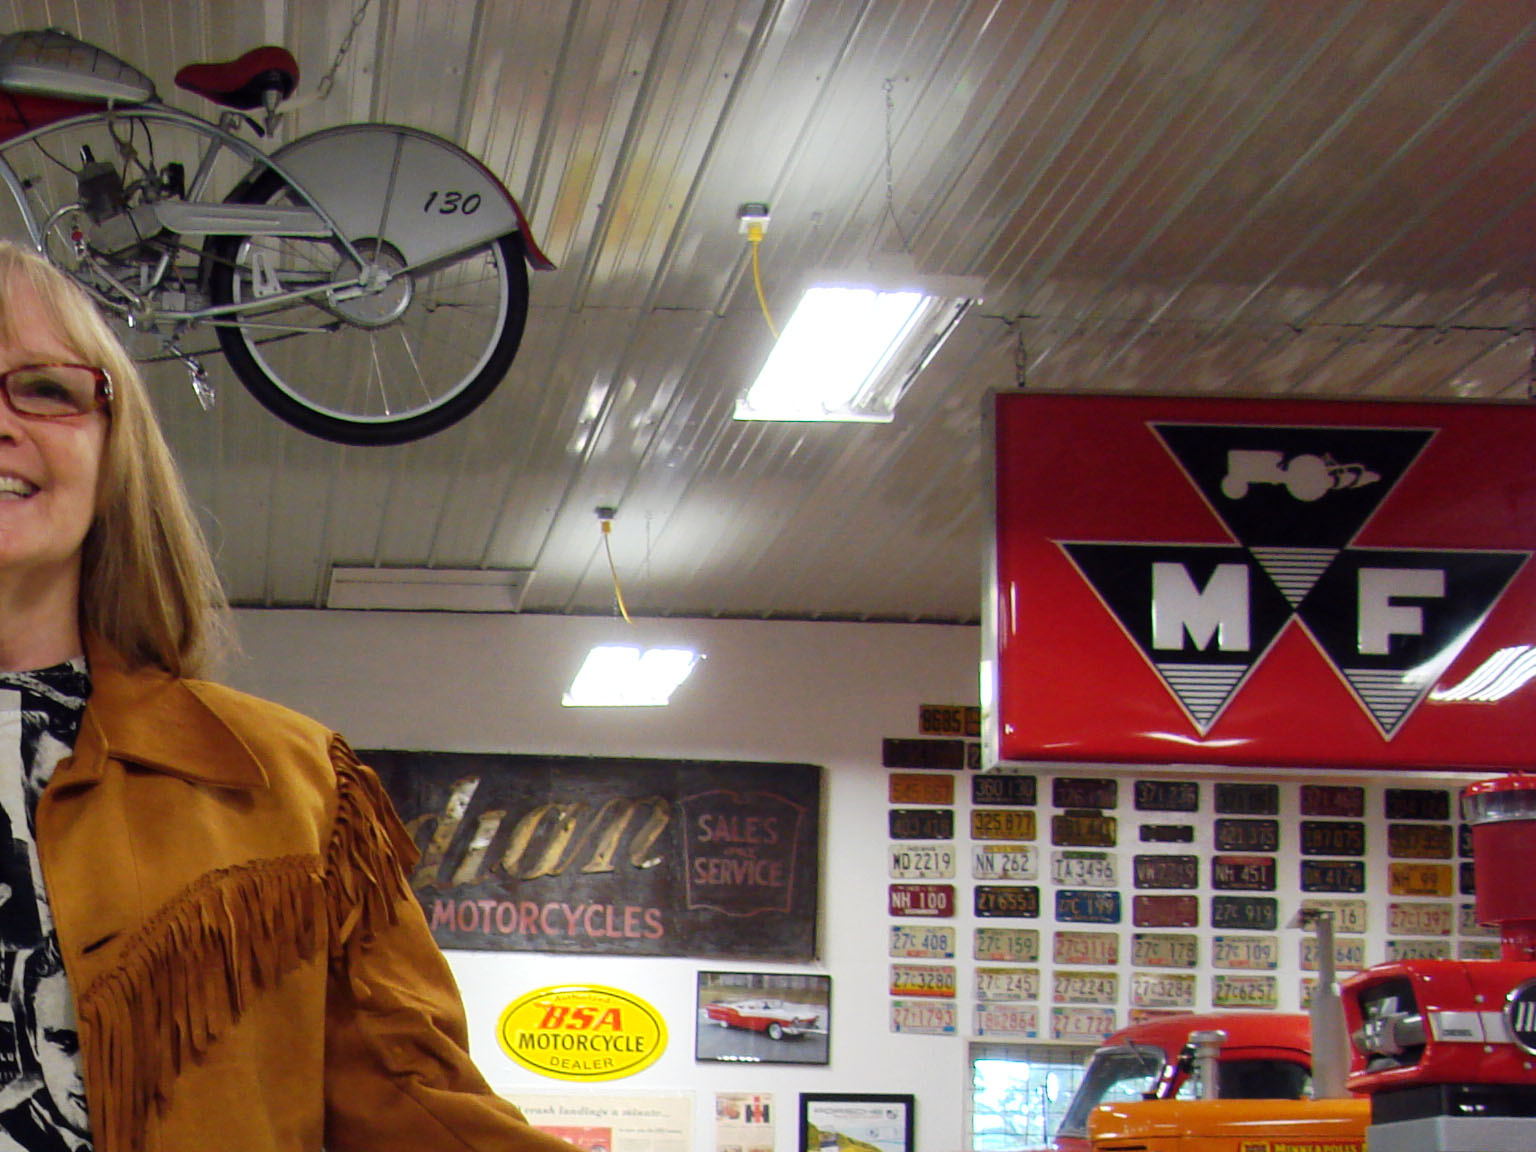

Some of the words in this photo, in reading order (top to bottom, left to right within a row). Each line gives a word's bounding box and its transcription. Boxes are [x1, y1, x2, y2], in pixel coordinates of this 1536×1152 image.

[423, 190, 482, 216] 130
[1151, 562, 1250, 652] M
[1357, 568, 1447, 656] F
[696, 813, 779, 846] SALES
[694, 856, 786, 888] SERVICE
[431, 897, 665, 940] MOTORCYCLES
[532, 1001, 624, 1032] BSA
[518, 1031, 646, 1053] MOTORCYCLE
[549, 1055, 615, 1071] DEALER
